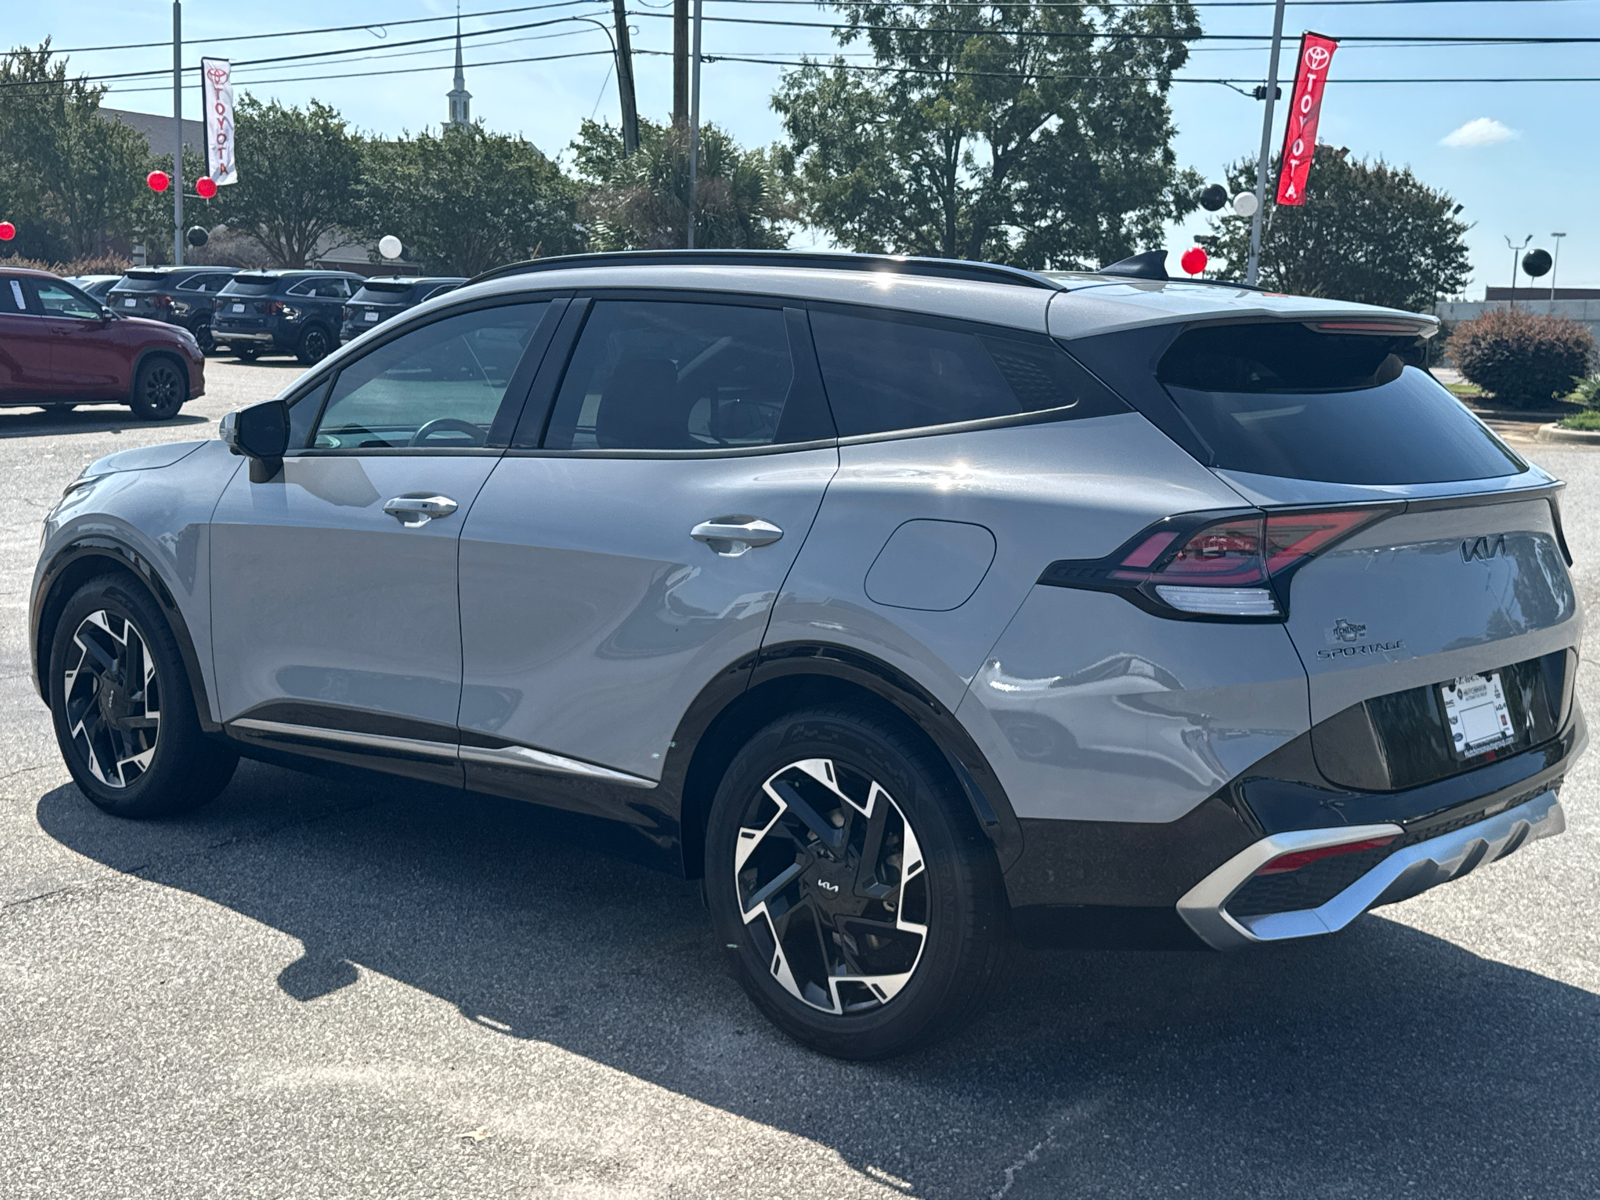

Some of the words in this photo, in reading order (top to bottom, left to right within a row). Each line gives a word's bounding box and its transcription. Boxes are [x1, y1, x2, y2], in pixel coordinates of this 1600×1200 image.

[214, 87, 229, 176] TOYOTA
[1285, 73, 1316, 199] TOYOTA
[1460, 533, 1506, 563] KIA
[1317, 639, 1405, 659] SPORTAGE
[818, 879, 839, 892] KIA
